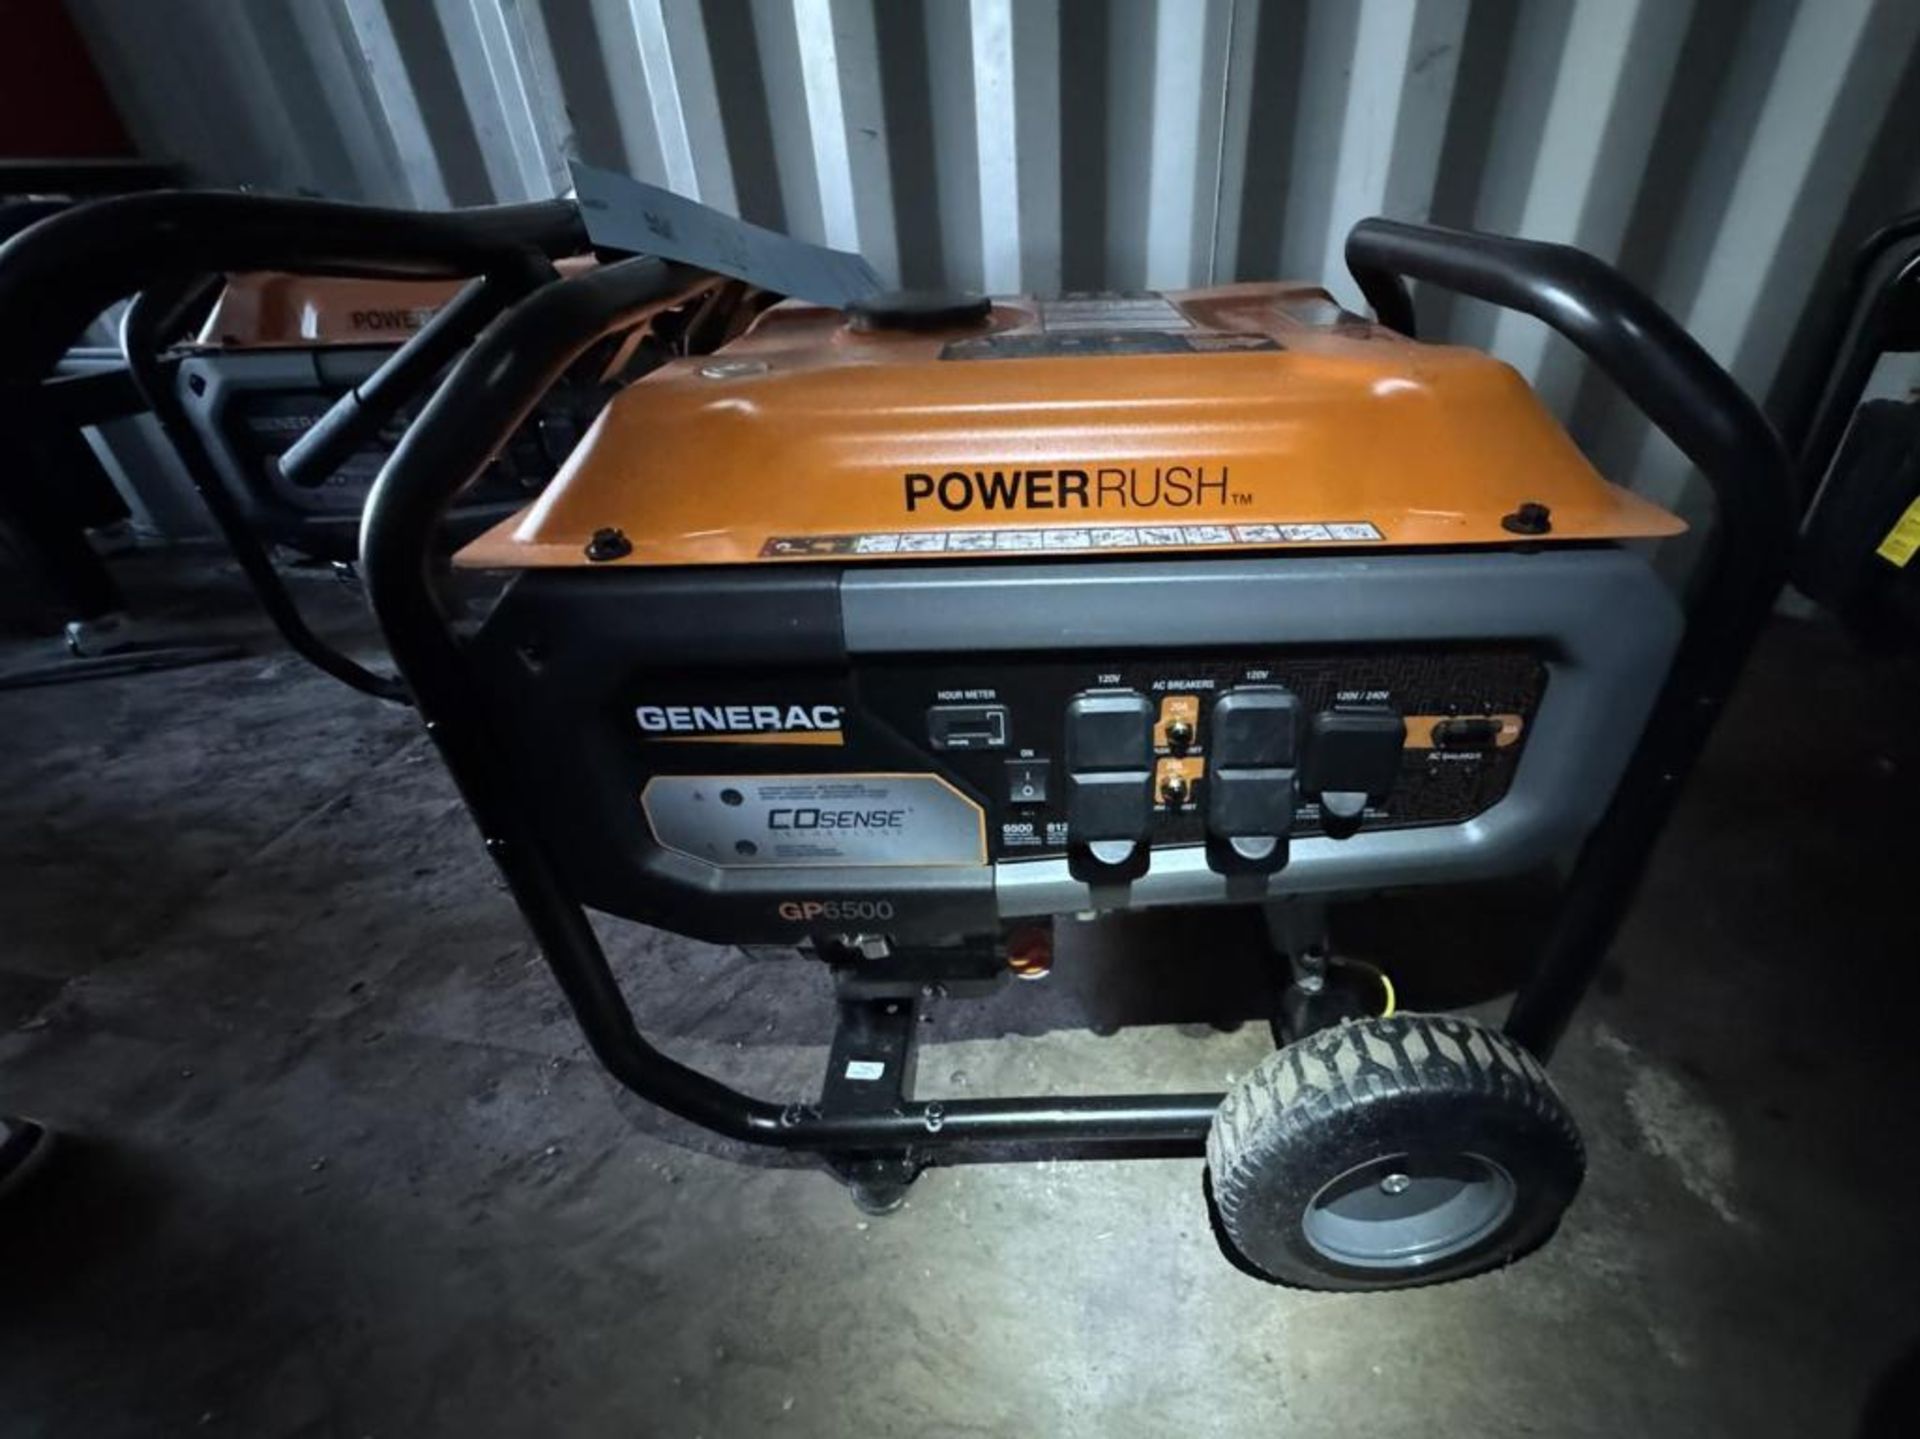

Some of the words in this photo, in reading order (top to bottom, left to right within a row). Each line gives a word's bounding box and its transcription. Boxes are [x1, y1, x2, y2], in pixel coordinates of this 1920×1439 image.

[1098, 674, 1121, 684] 120V
[1152, 681, 1166, 690] AC
[1167, 679, 1215, 690] BREAKERS
[937, 690, 963, 700] HOUR
[964, 689, 996, 699] METER
[636, 705, 842, 732] GENERAC
[1003, 823, 1034, 833] 6500
[778, 900, 894, 921] GP6500
